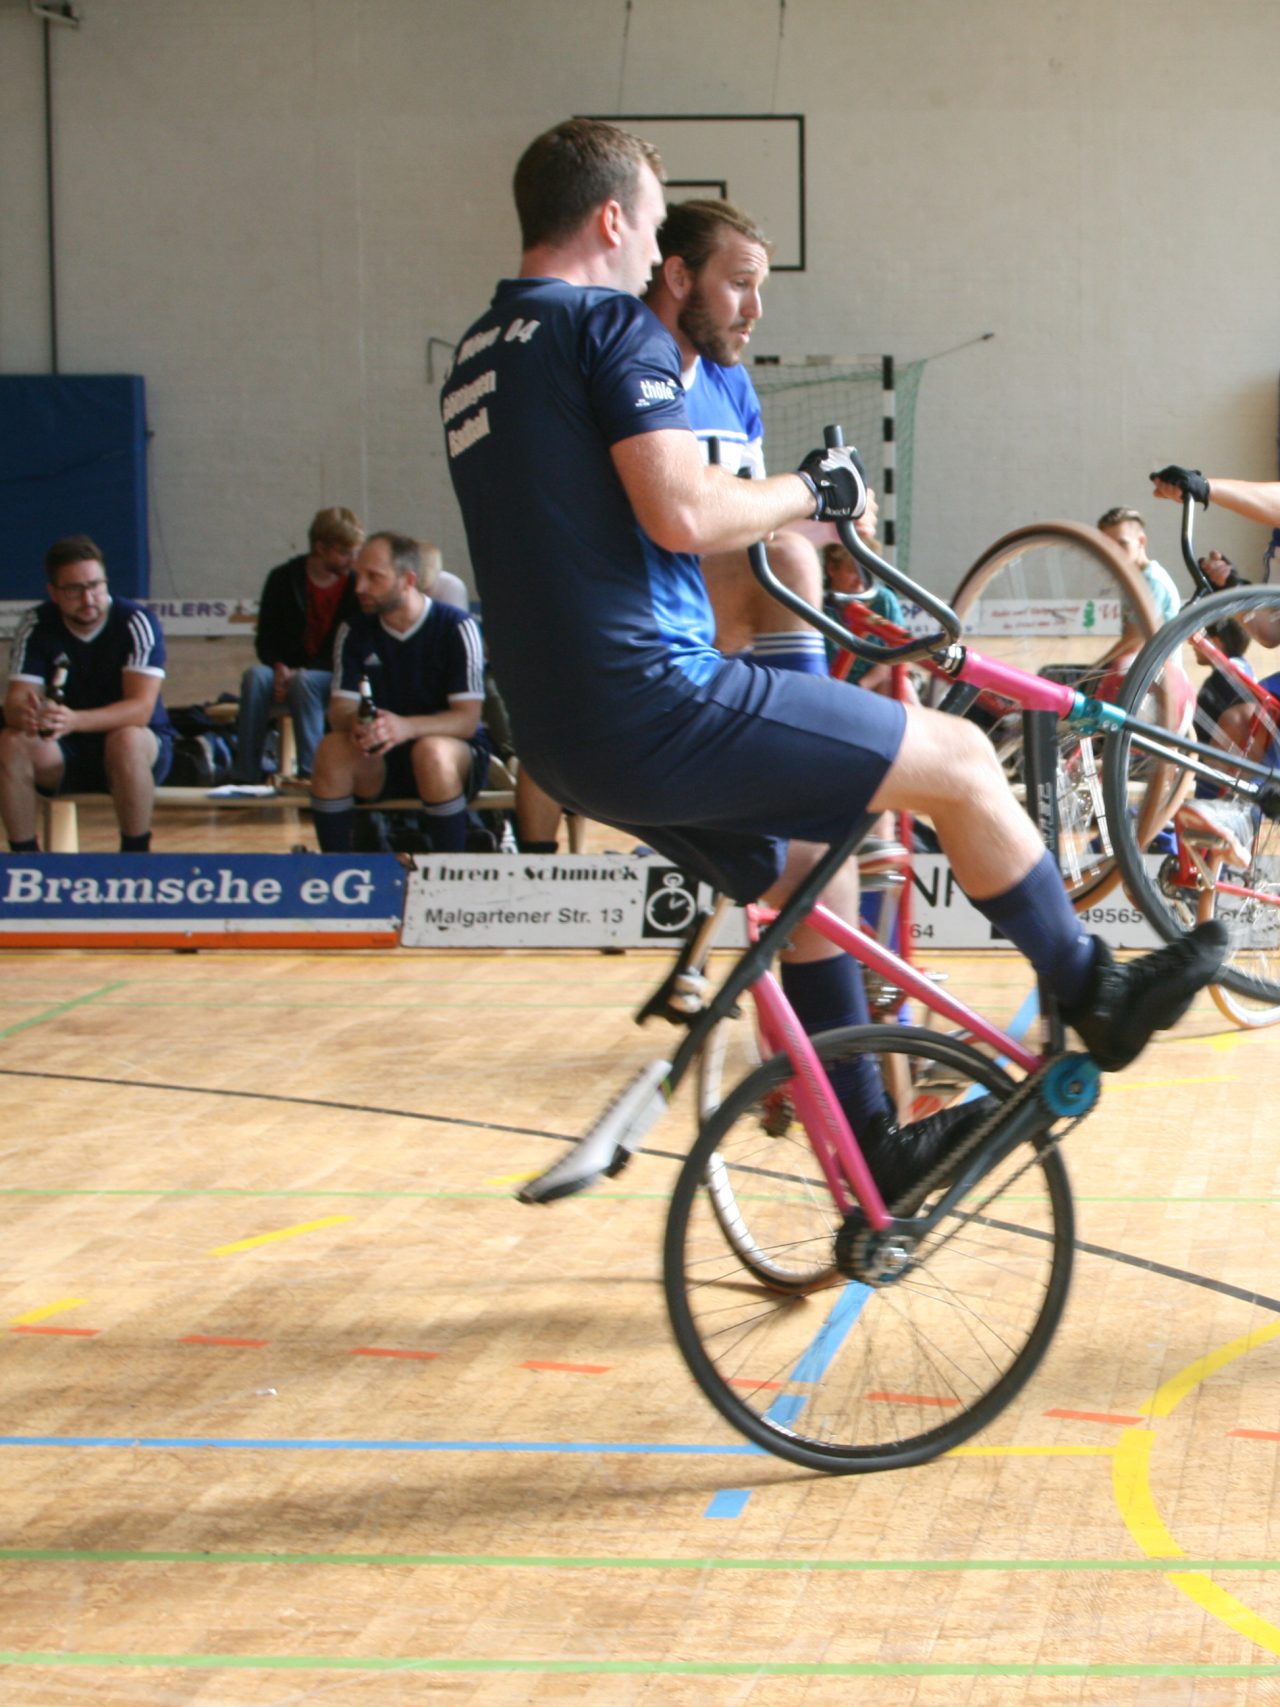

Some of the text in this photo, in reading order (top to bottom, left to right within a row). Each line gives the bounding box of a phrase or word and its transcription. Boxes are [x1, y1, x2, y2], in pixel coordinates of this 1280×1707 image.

[524, 865, 639, 881] Schmuck
[2, 868, 375, 904] Bramsche eG
[425, 907, 624, 929] Malgartener Str. 13
